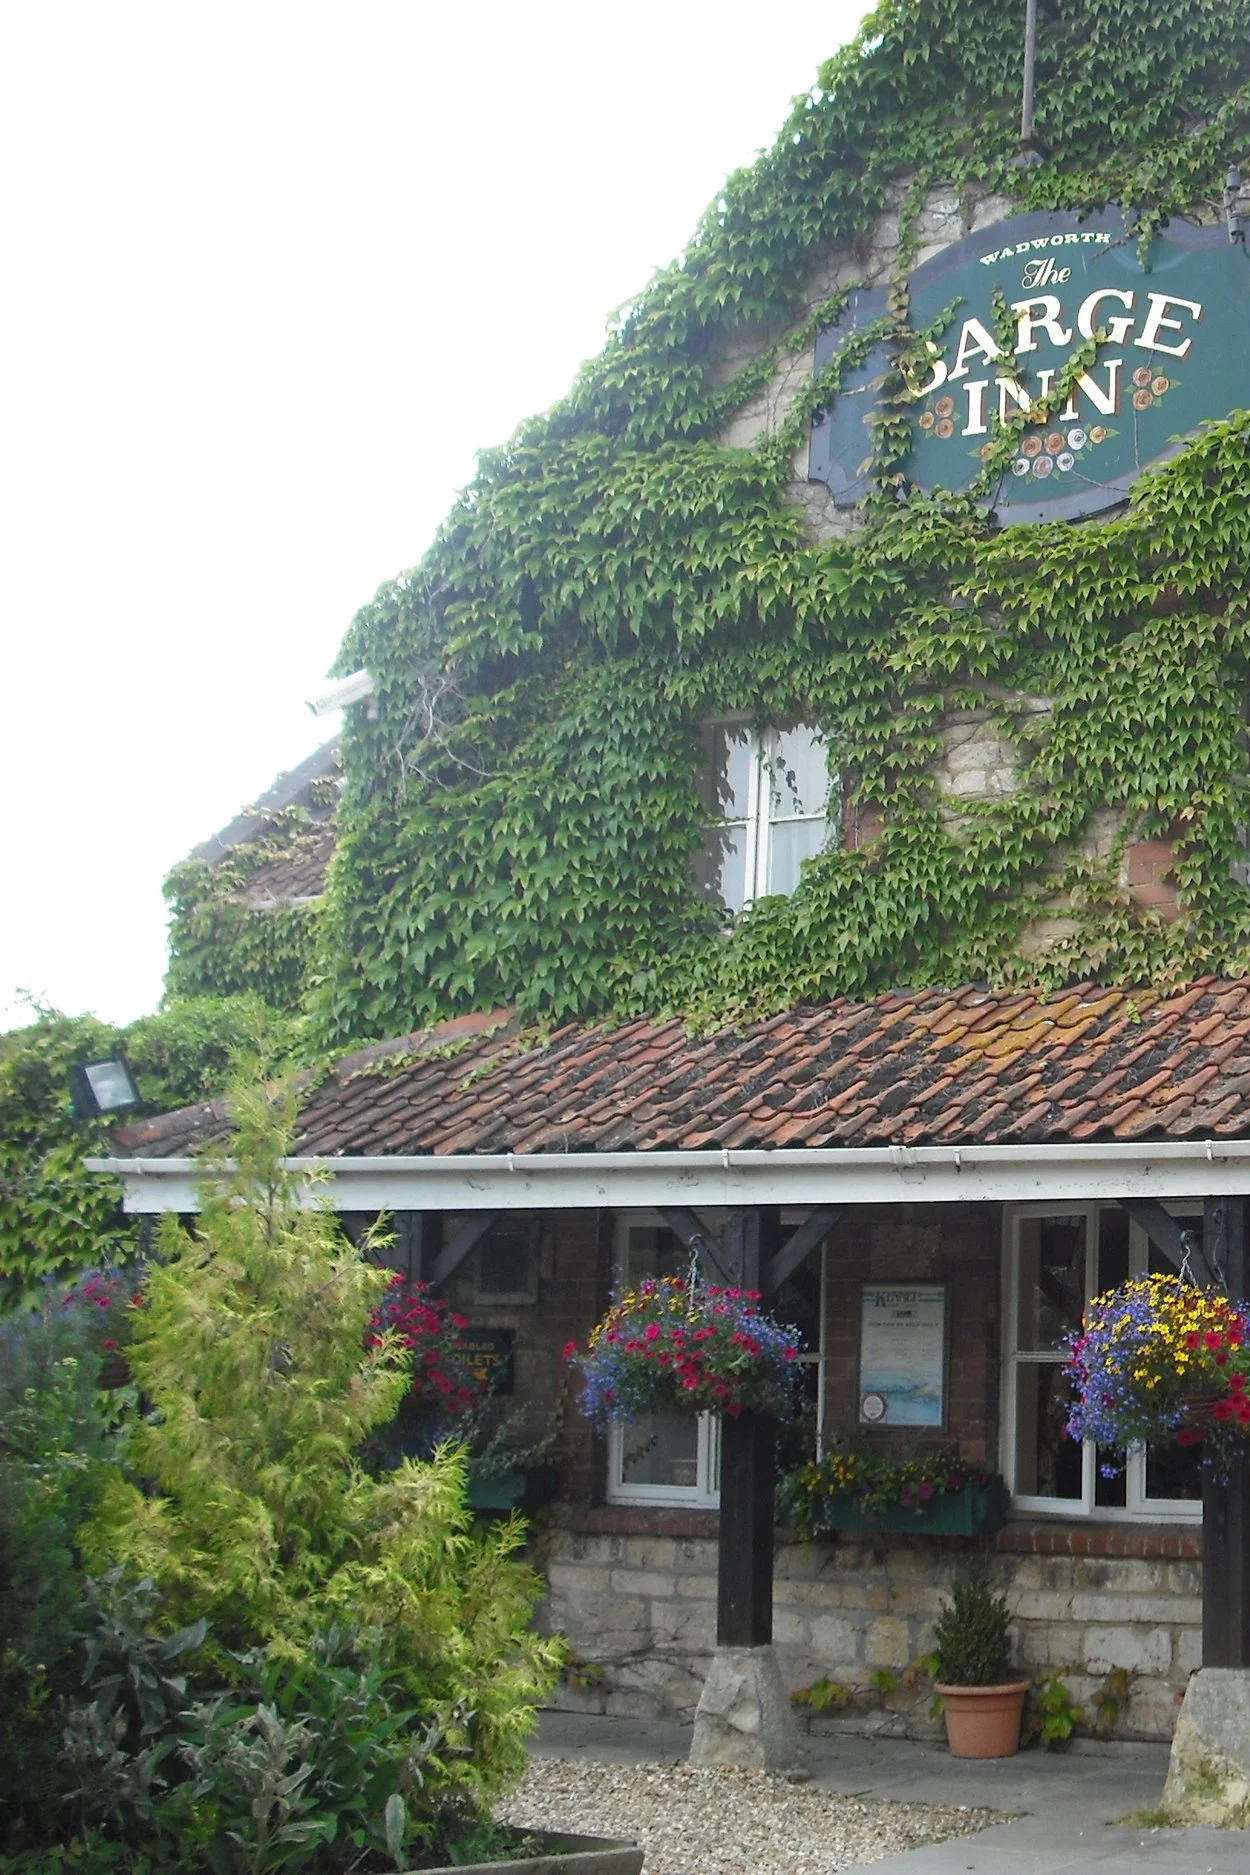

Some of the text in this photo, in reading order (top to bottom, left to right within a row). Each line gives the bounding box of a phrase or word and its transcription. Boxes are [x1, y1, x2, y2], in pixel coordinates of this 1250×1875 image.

[978, 232, 1112, 266] WADWORTH
[1021, 258, 1072, 290] The
[960, 358, 1123, 437] INN
